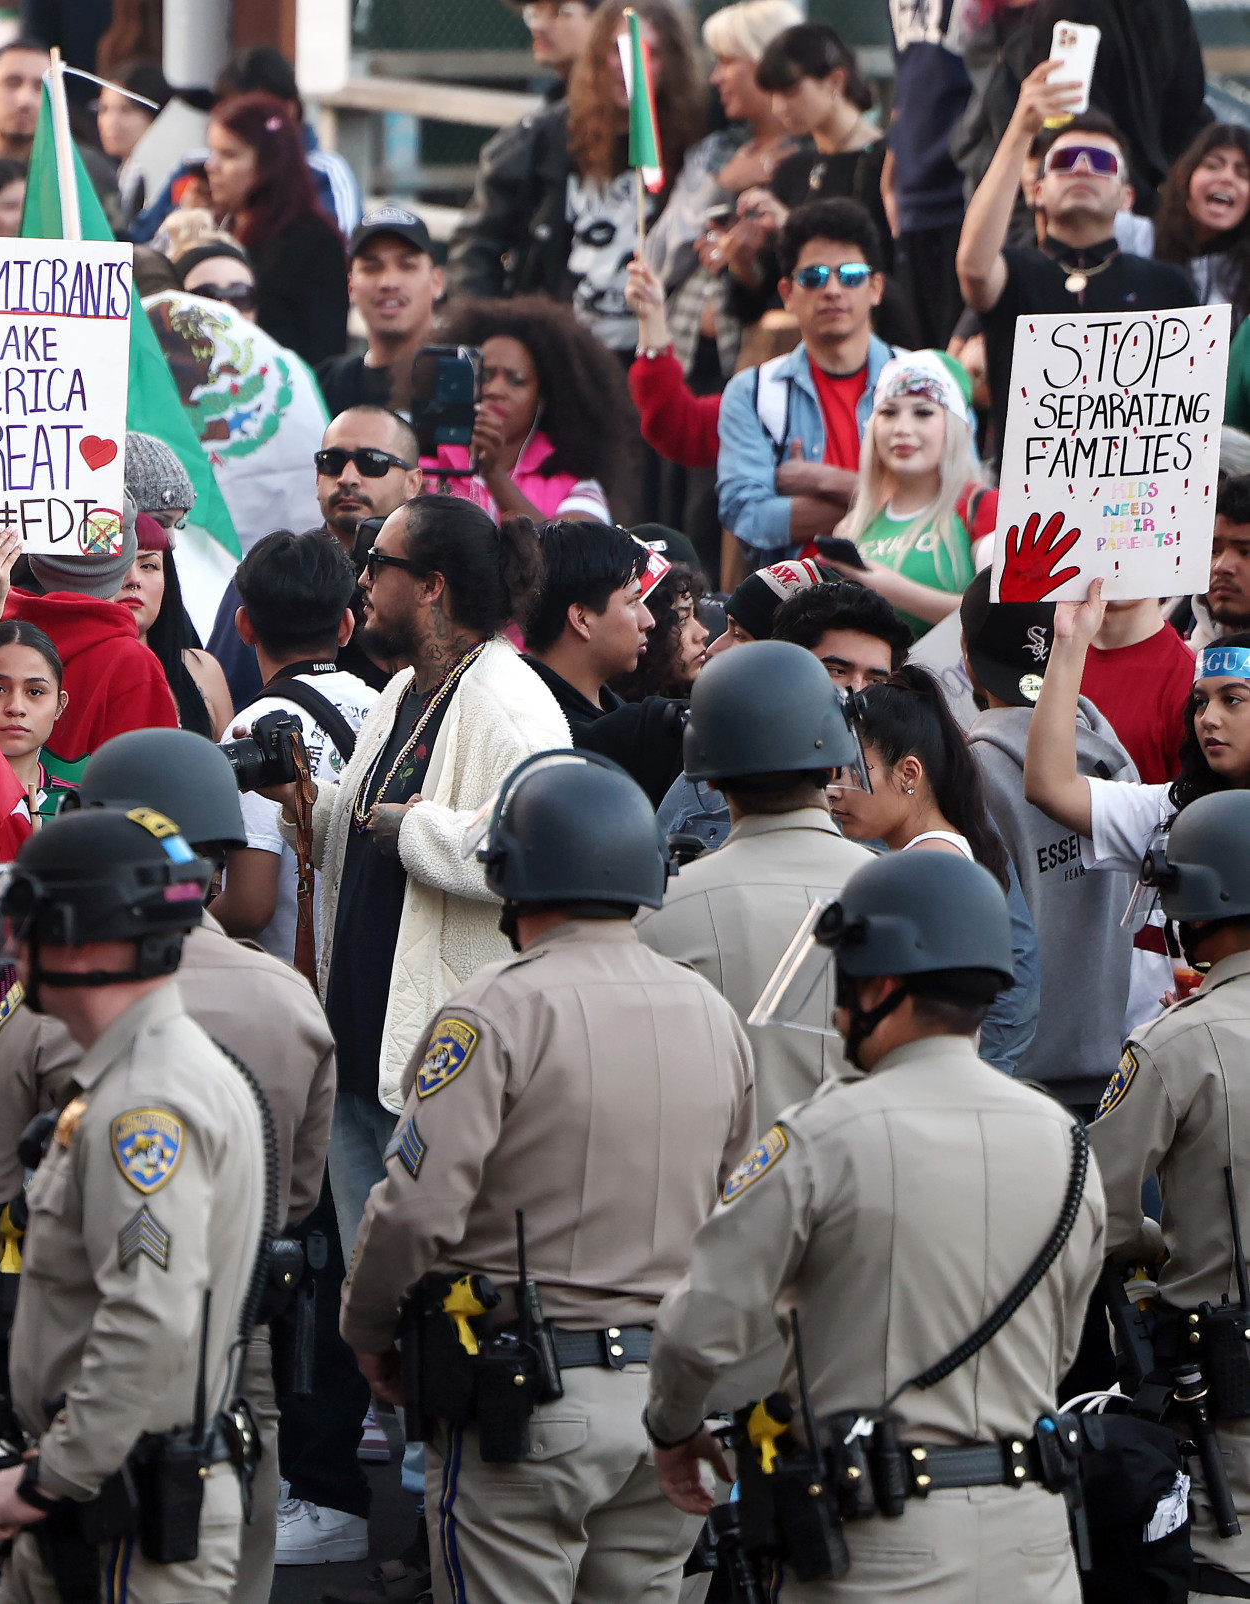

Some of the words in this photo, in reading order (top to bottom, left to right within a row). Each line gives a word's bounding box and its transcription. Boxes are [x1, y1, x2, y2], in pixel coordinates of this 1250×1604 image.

[1043, 317, 1190, 389] STOP
[1033, 393, 1210, 430] SEPARATING
[1026, 432, 1192, 478] FAMILIES
[1111, 481, 1159, 500] KIDS
[1102, 502, 1154, 517] NEED
[1103, 518, 1155, 533] THEIR
[1037, 833, 1082, 874] ESSE
[1064, 864, 1086, 882] FEAR
